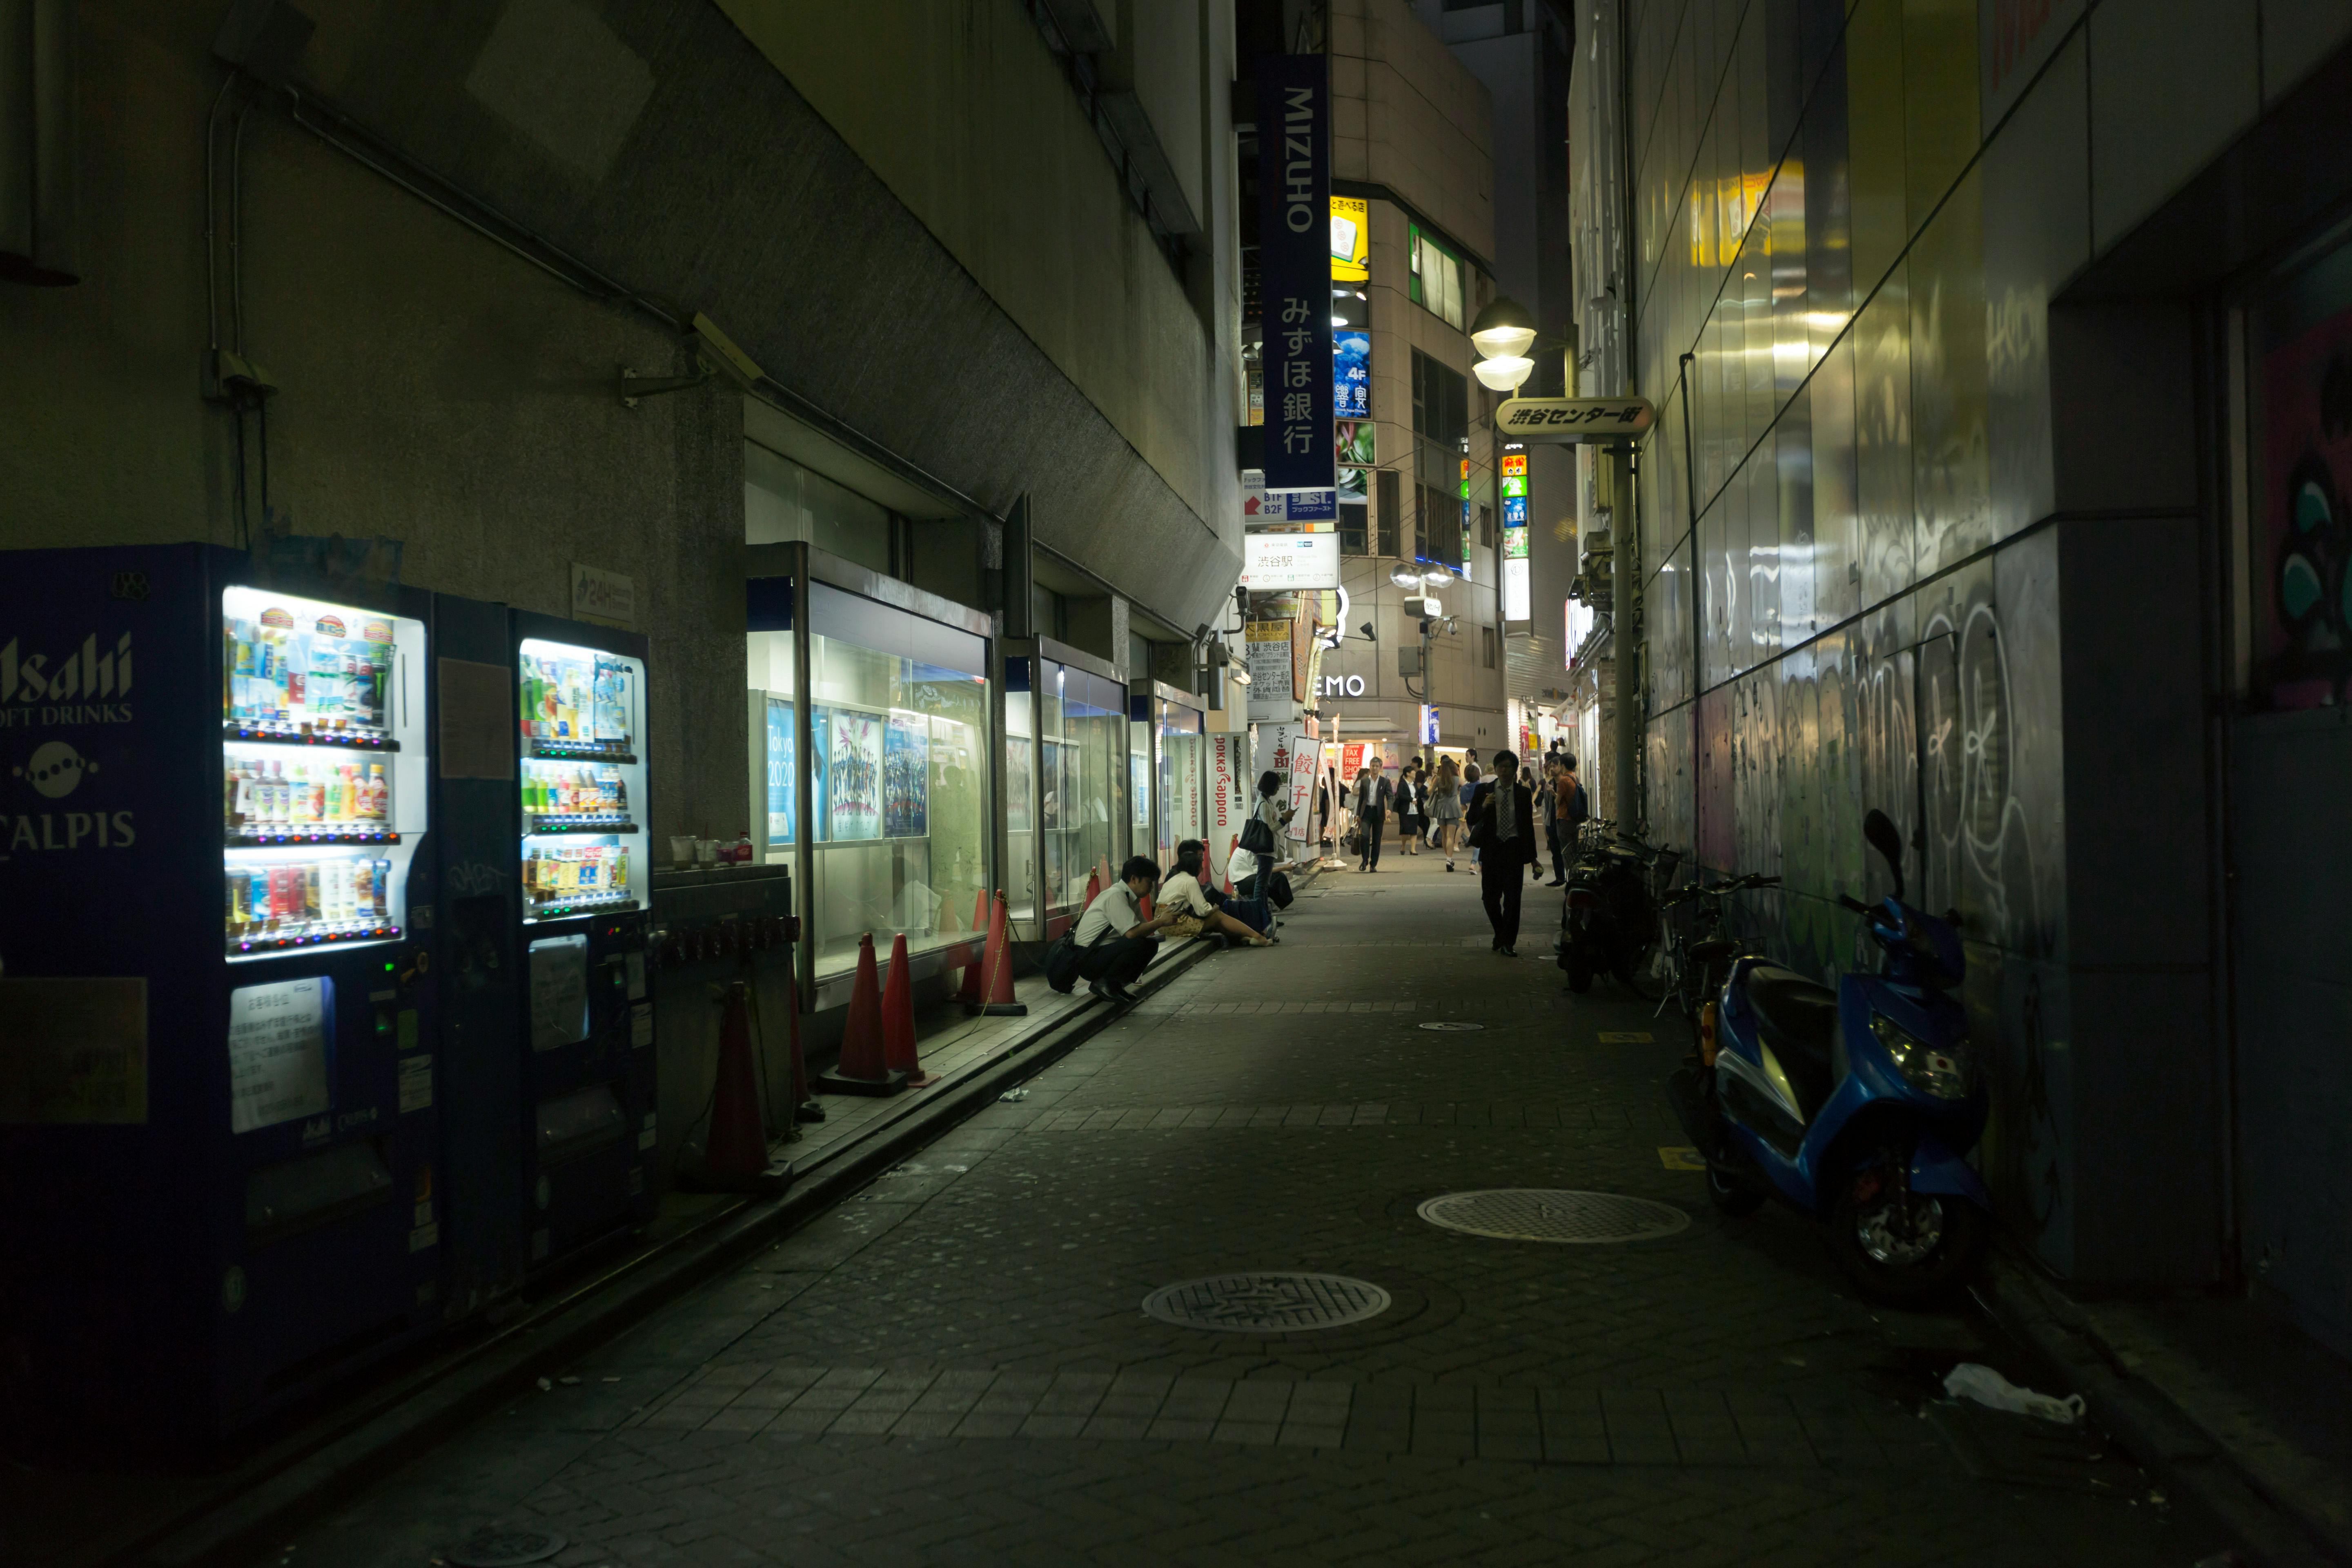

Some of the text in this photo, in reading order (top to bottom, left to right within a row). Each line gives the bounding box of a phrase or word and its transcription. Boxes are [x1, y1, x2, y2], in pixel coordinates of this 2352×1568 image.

[1285, 87, 1313, 233] MIZUHO
[1281, 298, 1314, 454] みずほ銀行
[1348, 367, 1366, 380] 4F
[1508, 407, 1643, 425] 渋谷センター街
[1264, 493, 1282, 501] B1F
[1265, 505, 1282, 514] B2F
[1258, 555, 1293, 567] 渋谷駅
[1245, 622, 1284, 633] 大黒屋
[1263, 642, 1289, 652] 渋谷店
[1252, 671, 1290, 681] 渋谷センター街店
[41, 703, 133, 727] DRINKS
[767, 725, 793, 758] Tokyo
[1345, 757, 1360, 765] FREE
[768, 760, 794, 787] 2020
[1293, 753, 1313, 806] 餃子
[0, 810, 136, 851] ALPIS
